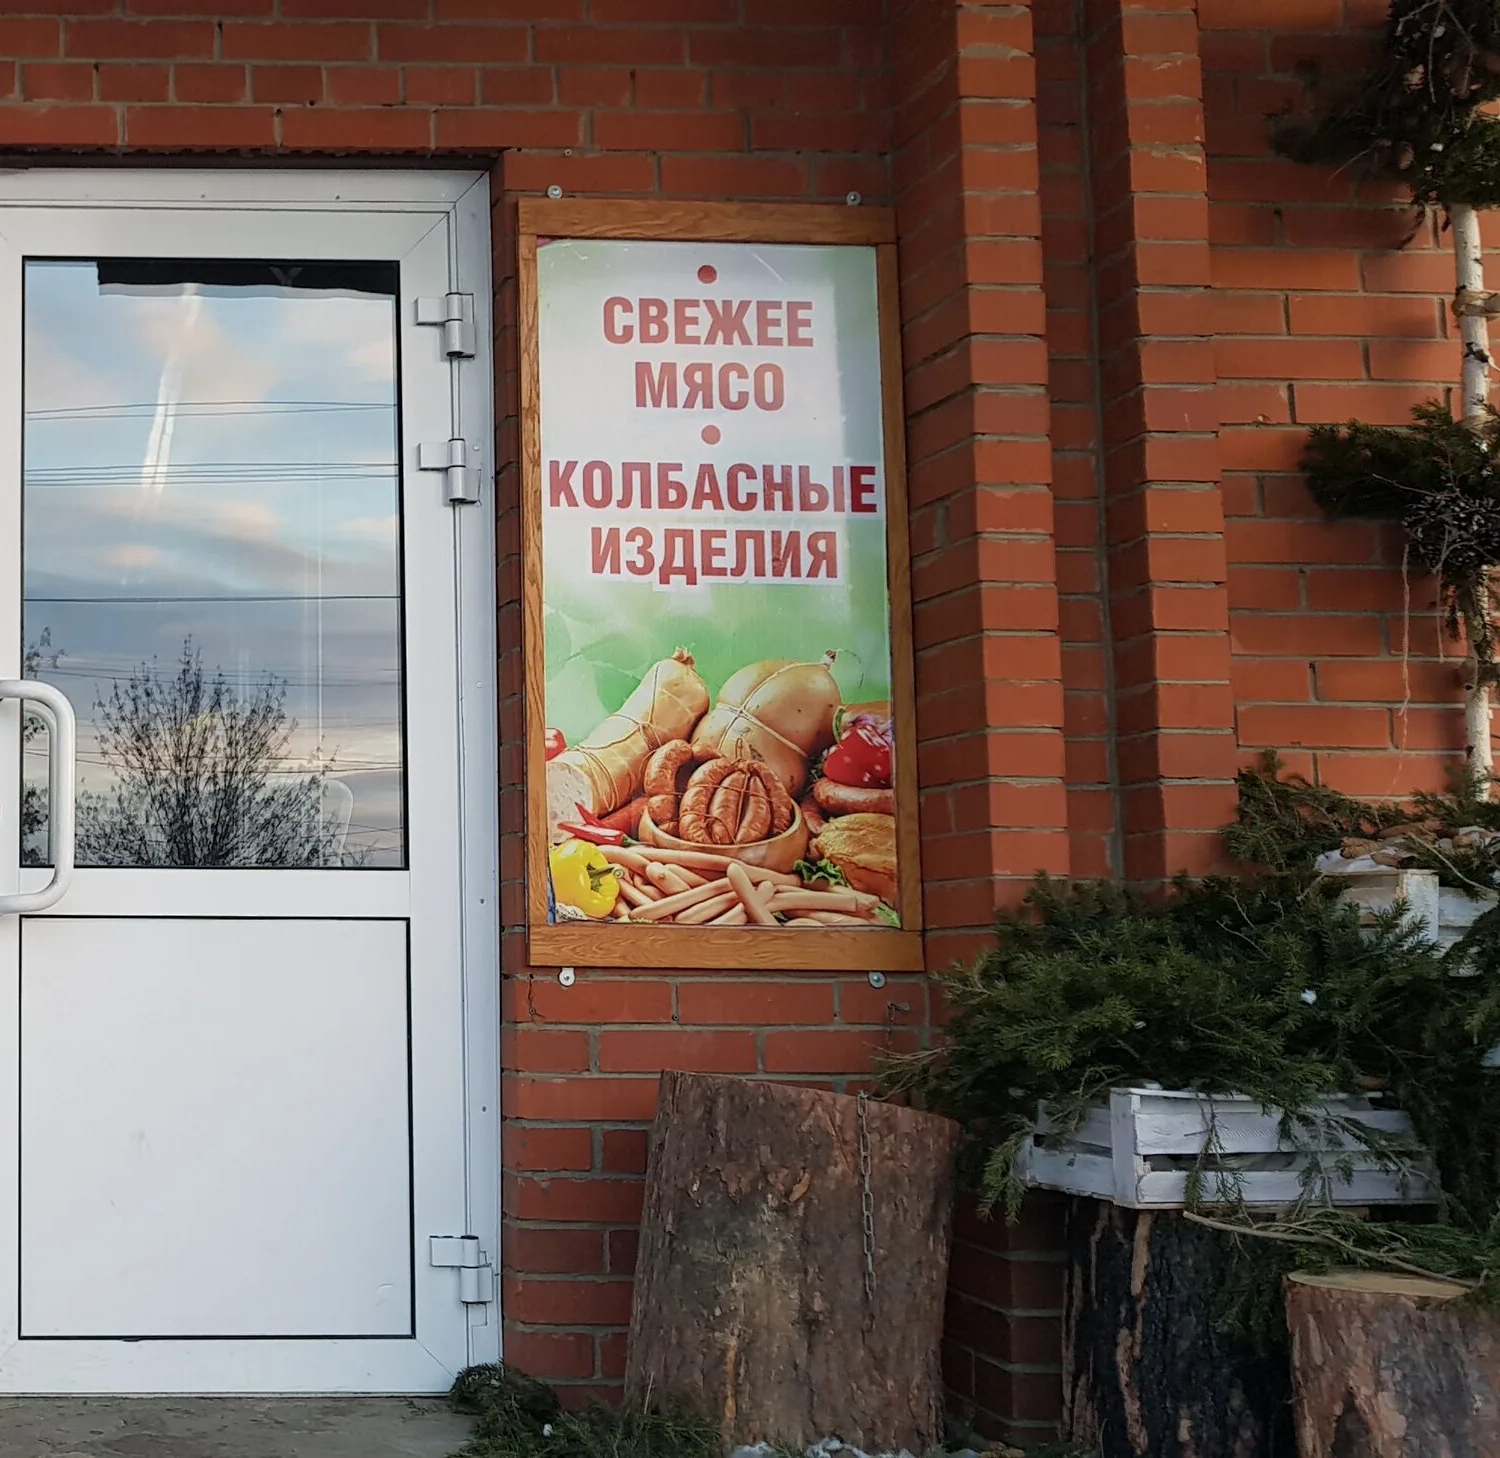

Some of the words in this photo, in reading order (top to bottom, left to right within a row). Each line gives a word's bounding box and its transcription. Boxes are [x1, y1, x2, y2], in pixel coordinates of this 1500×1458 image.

[603, 296, 813, 347] СВЕЖЕЕ
[635, 362, 784, 411] МЯСО
[549, 460, 877, 513] КОЛБАСНЫЕ
[591, 526, 838, 585] ИЗДЕЛИЯ
